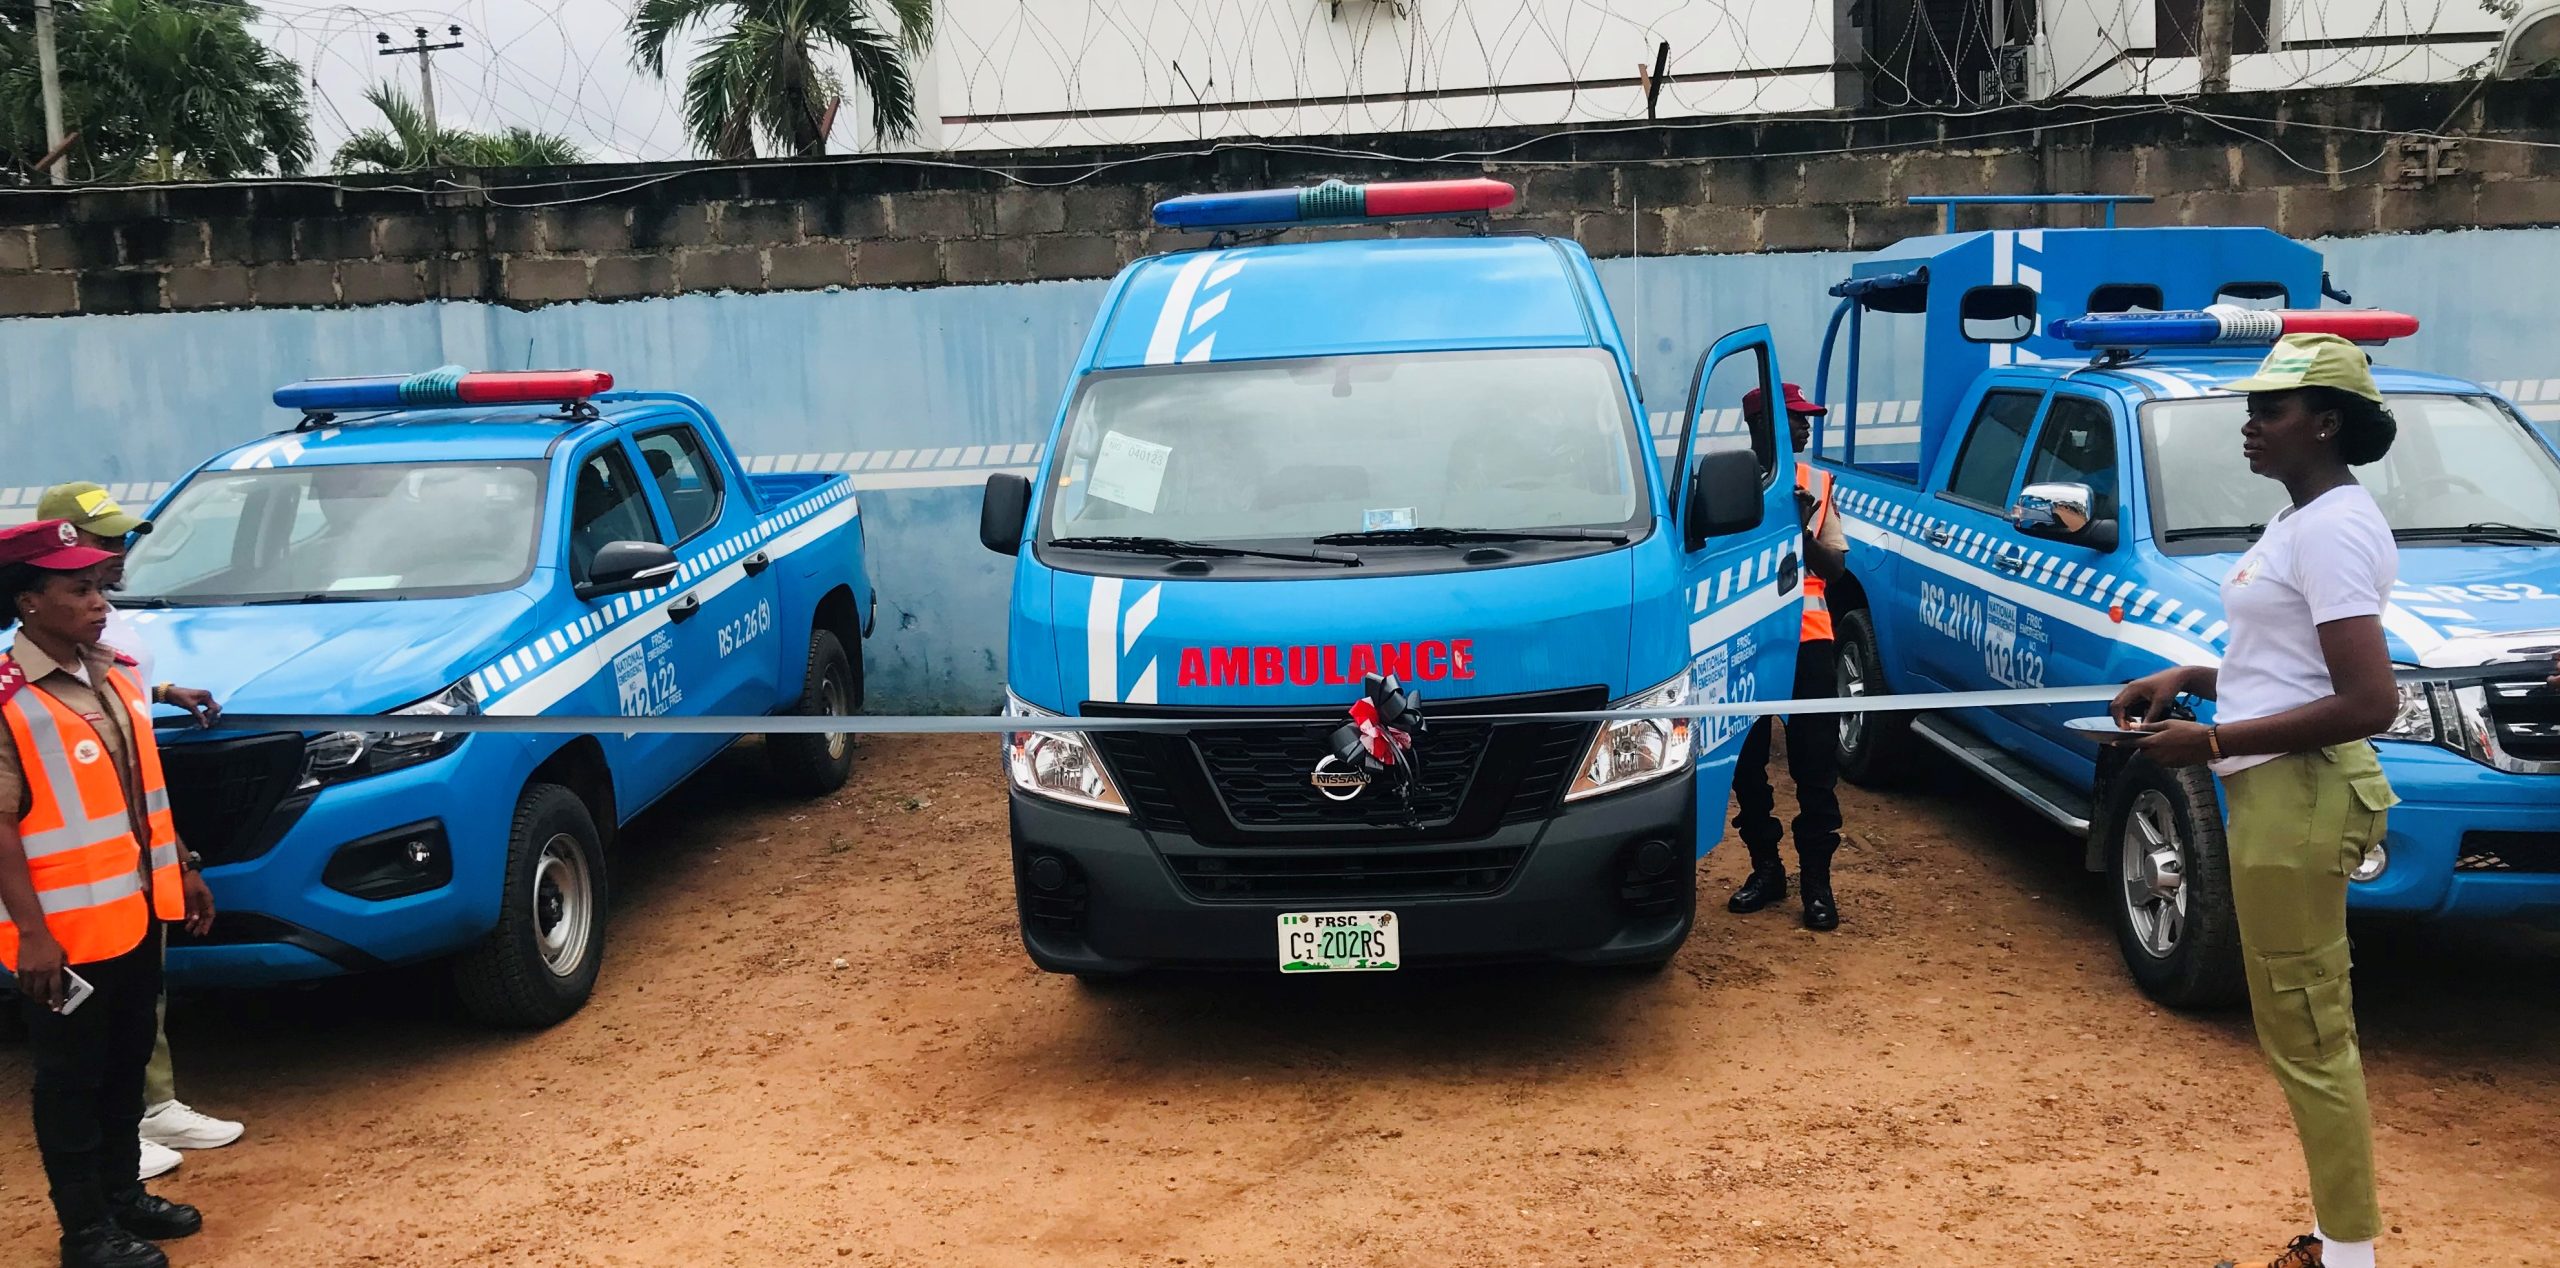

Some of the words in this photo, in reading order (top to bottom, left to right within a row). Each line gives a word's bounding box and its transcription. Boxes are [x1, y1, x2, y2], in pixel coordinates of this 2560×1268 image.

[1989, 601, 2015, 622] NATIONAL
[2026, 612, 2043, 630] FRSC
[1988, 614, 2015, 633] EMERGENCY
[2020, 623, 2049, 643] EMERGENCY
[651, 629, 666, 648] FRSC
[718, 624, 733, 659] RS
[616, 650, 643, 672] NATIONAL
[647, 639, 673, 662] EMERGENCY
[1986, 639, 2013, 682] 112
[1177, 638, 1476, 687] AMBULANCE
[1698, 650, 1727, 675] NATIONAL
[2017, 647, 2045, 688] 122
[618, 663, 645, 686] EMERGENCY
[652, 663, 677, 704] 122
[1698, 665, 1727, 690] EMERGENCY
[1317, 774, 1363, 784] NISSAN
[1315, 915, 1358, 928] FRSC
